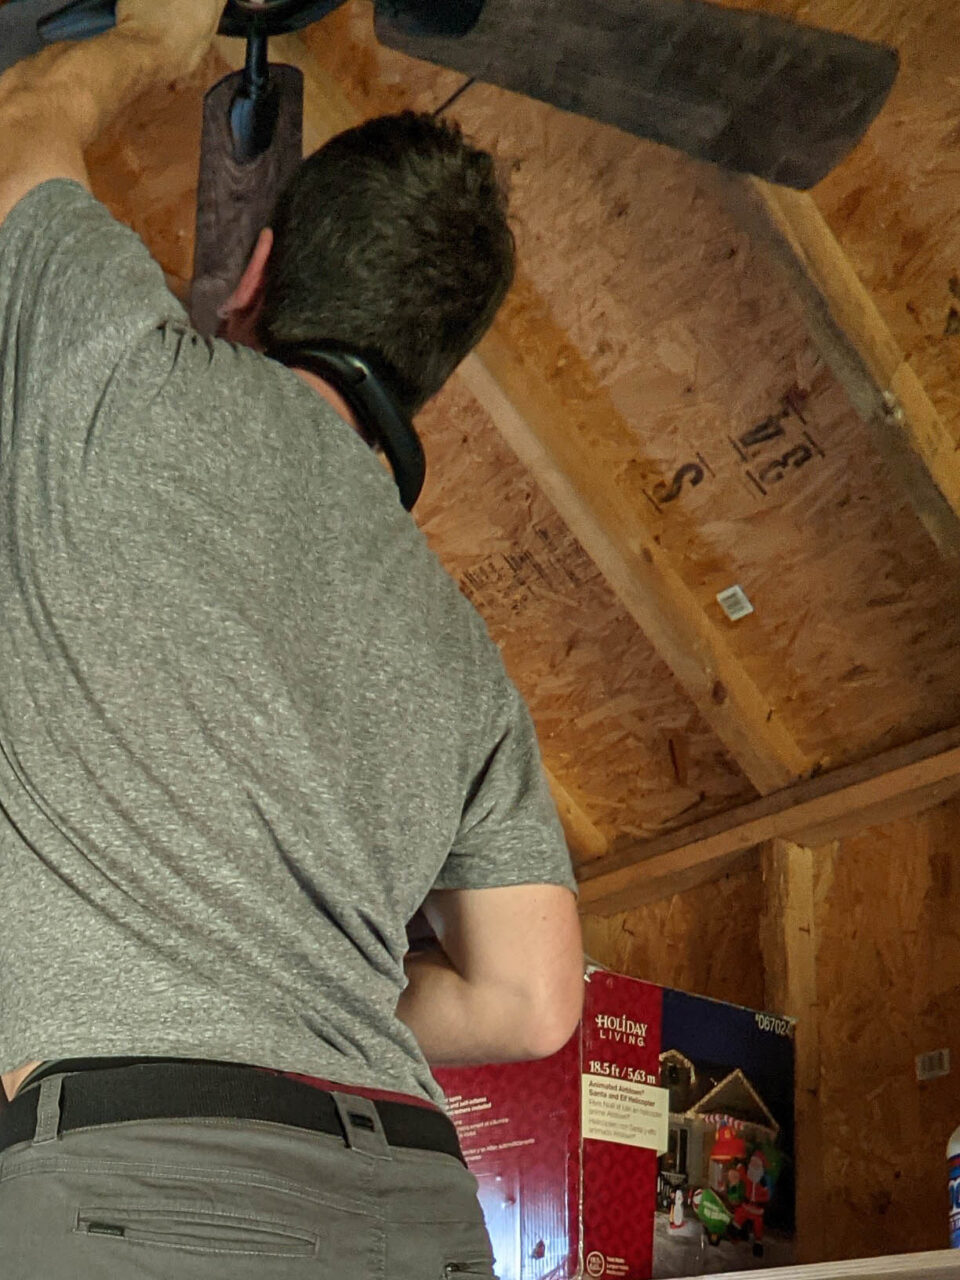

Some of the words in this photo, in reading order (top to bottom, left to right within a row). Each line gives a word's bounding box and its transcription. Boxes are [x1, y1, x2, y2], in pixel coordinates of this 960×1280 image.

[599, 1030, 645, 1047] LIVING
[589, 1060, 610, 1075] 18.5
[611, 1064, 620, 1077] ft
[646, 1074, 656, 1084] m
